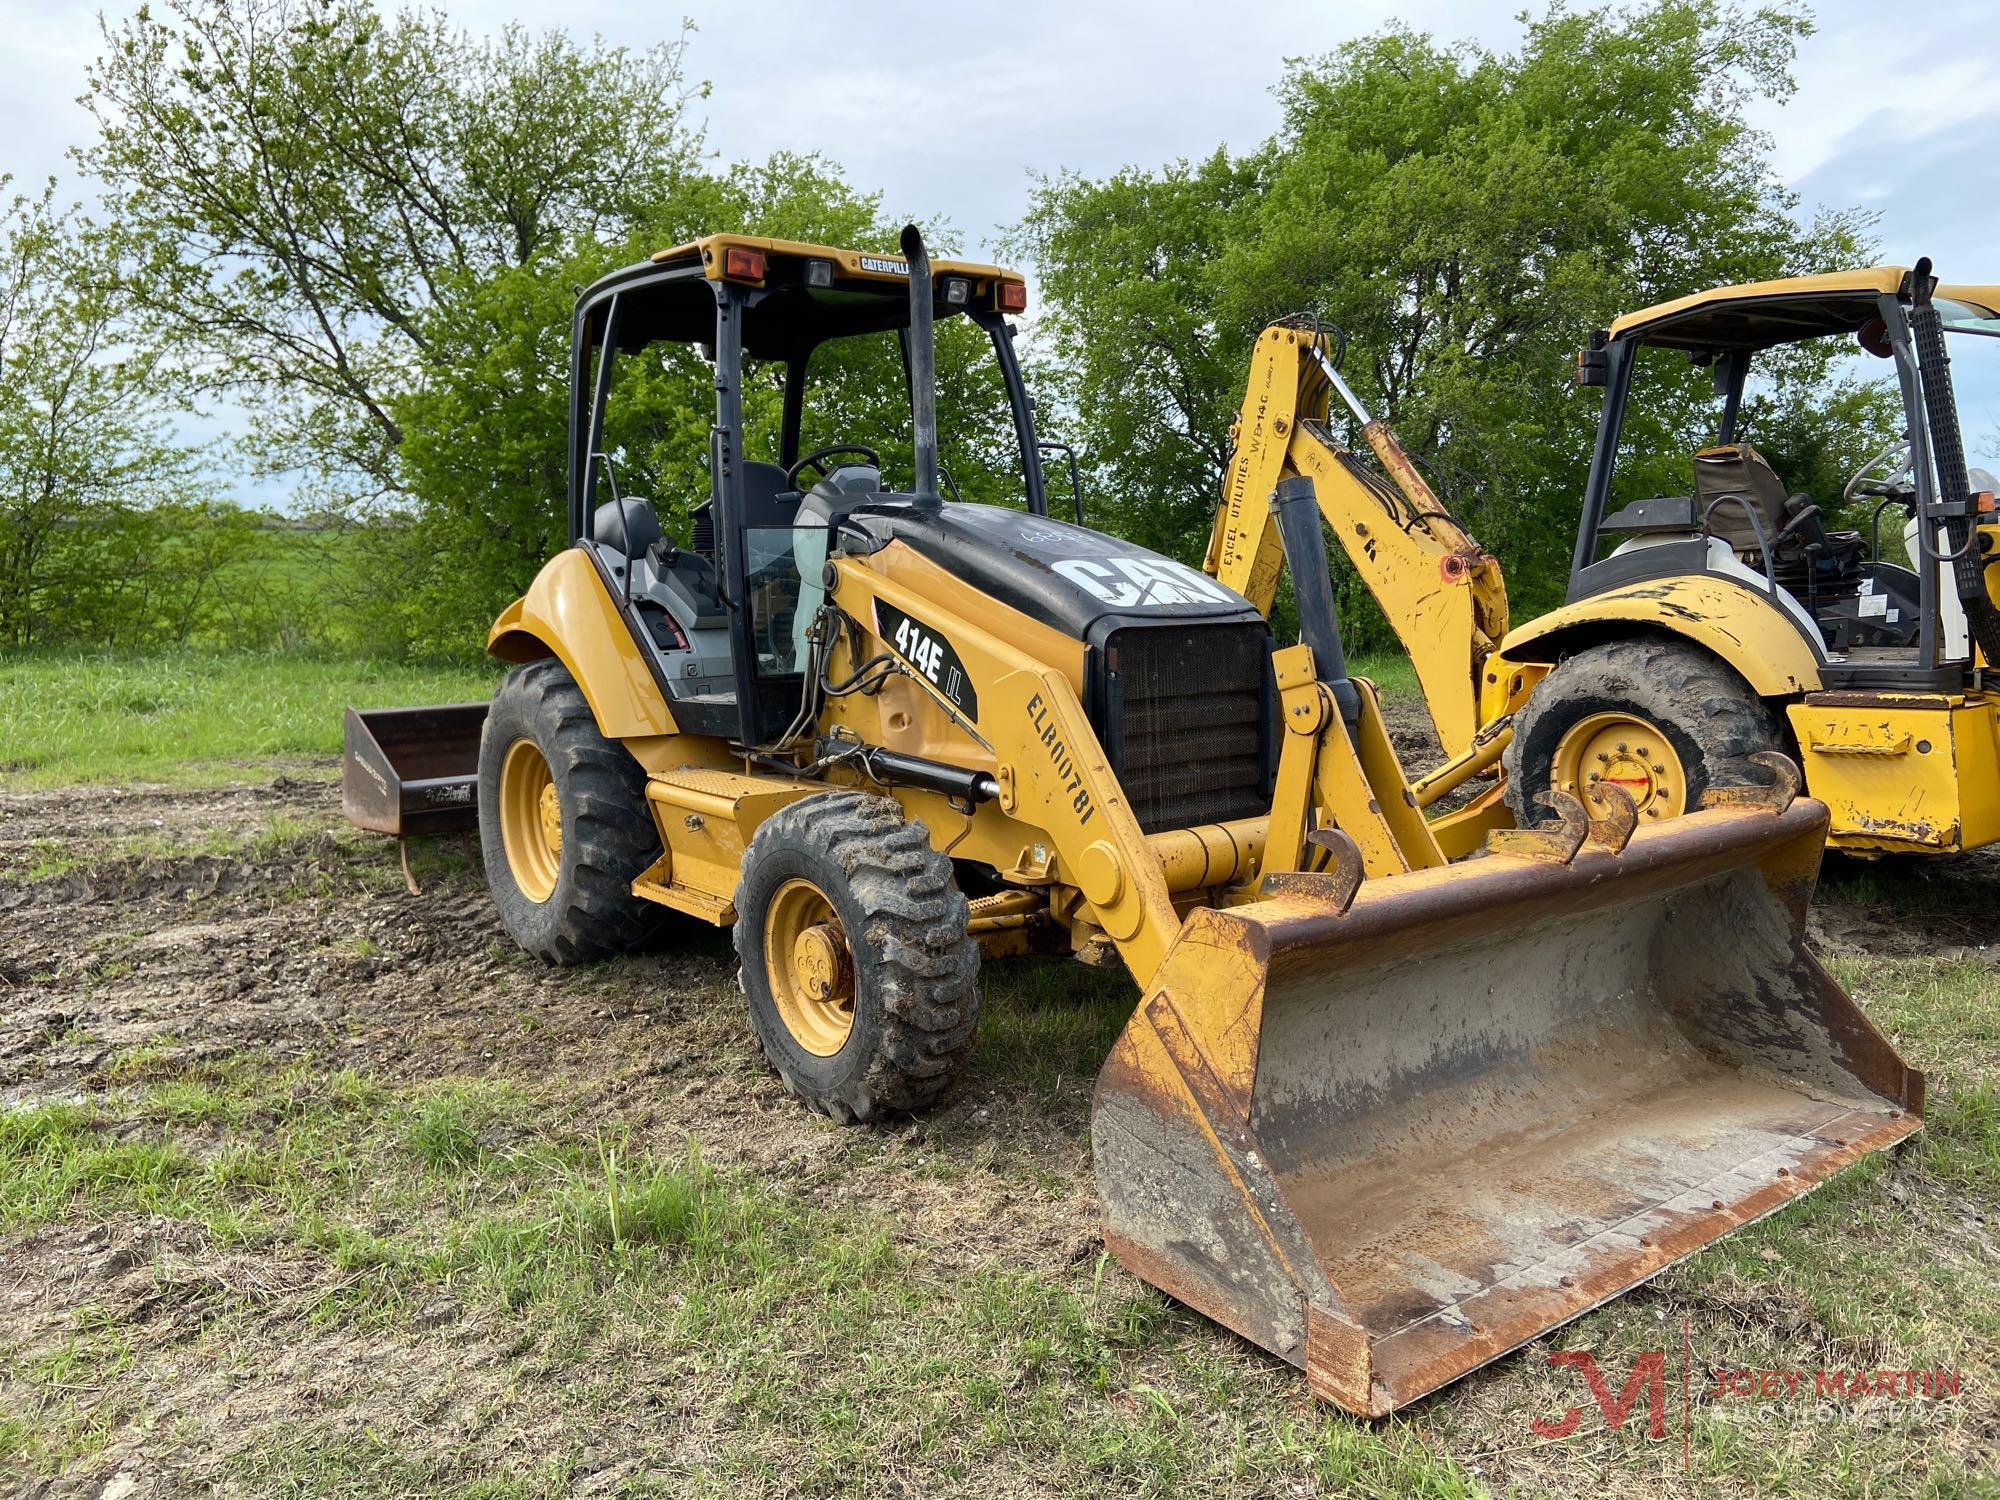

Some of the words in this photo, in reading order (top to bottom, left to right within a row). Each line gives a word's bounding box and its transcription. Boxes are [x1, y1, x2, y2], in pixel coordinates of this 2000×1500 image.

[1223, 527, 1237, 566] EXCEL
[1231, 457, 1249, 518] UTILITIES
[1050, 558, 1236, 607] CAT
[895, 617, 944, 685] 414E
[1026, 692, 1095, 826] ELB00781
